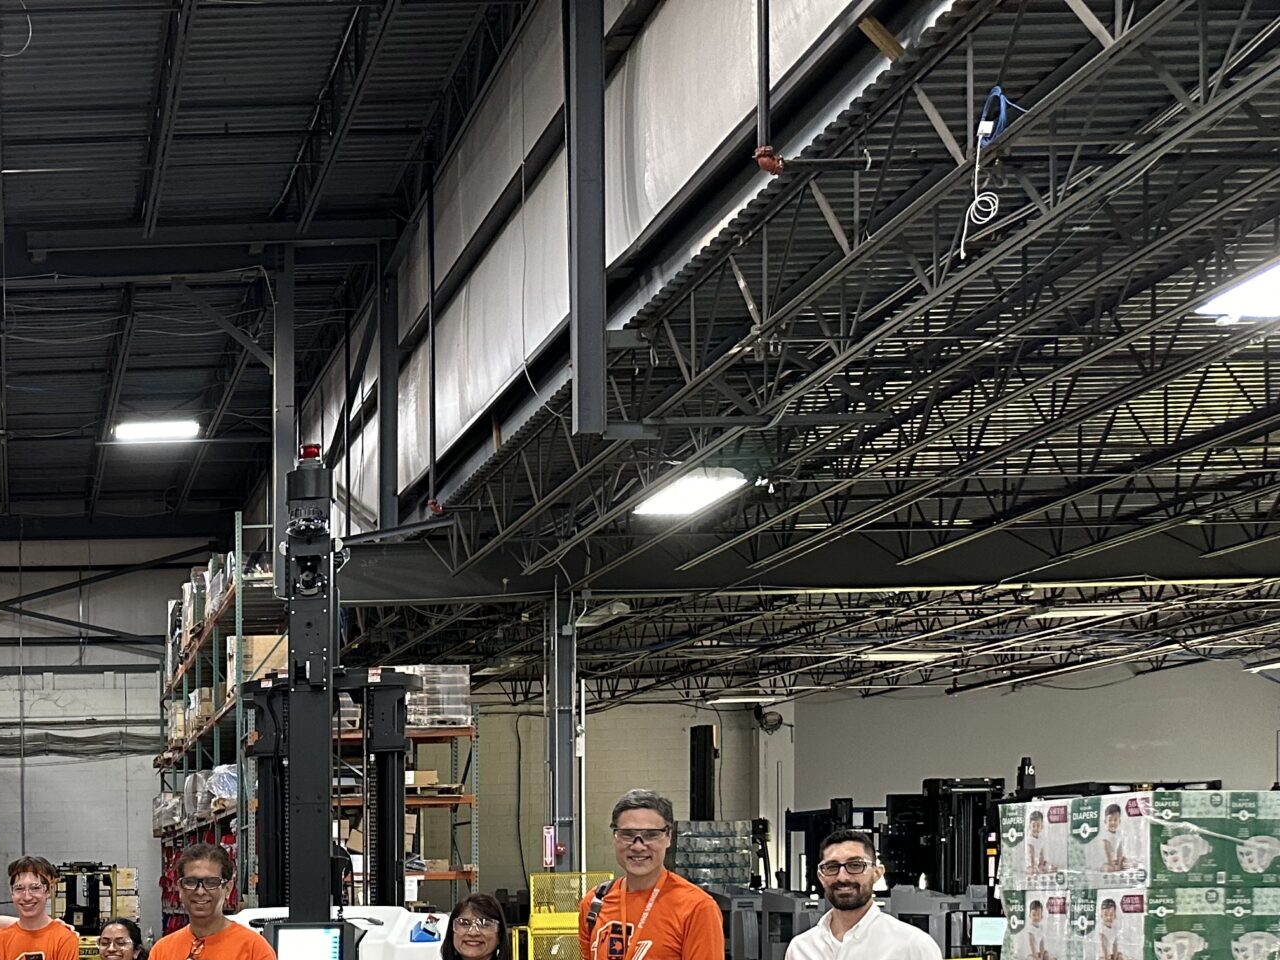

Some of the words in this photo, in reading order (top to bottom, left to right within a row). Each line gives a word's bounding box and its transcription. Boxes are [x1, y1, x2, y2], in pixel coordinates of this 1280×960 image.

[1025, 765, 1035, 775] 16
[1073, 811, 1098, 820] DIAPERS
[1002, 817, 1023, 825] DIAPERS
